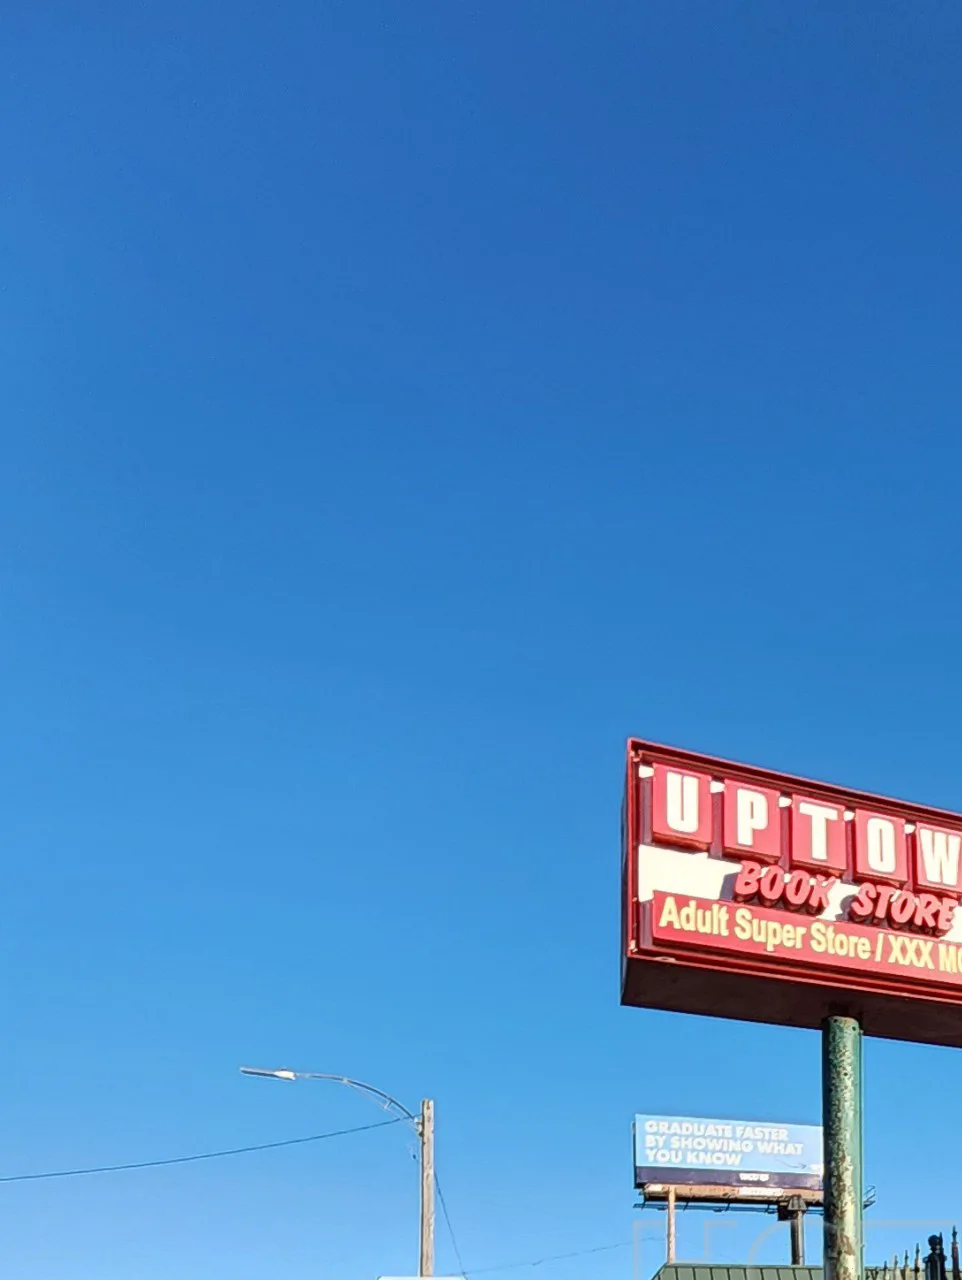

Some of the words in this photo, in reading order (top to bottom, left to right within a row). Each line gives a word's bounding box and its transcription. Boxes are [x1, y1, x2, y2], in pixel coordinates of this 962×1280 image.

[734, 860, 838, 910] BOOK
[851, 882, 959, 934] STORE
[659, 896, 729, 935] Adult
[734, 908, 807, 951] Super
[810, 921, 871, 960] Store
[888, 936, 936, 970] XXX
[645, 1120, 732, 1138] GRADUATE
[736, 1126, 789, 1141] FASTER
[645, 1134, 665, 1148] BY
[670, 1136, 754, 1152] SHOWING
[756, 1142, 804, 1155] WHAT
[646, 1149, 683, 1164] YOU
[686, 1151, 743, 1166] KNOW
